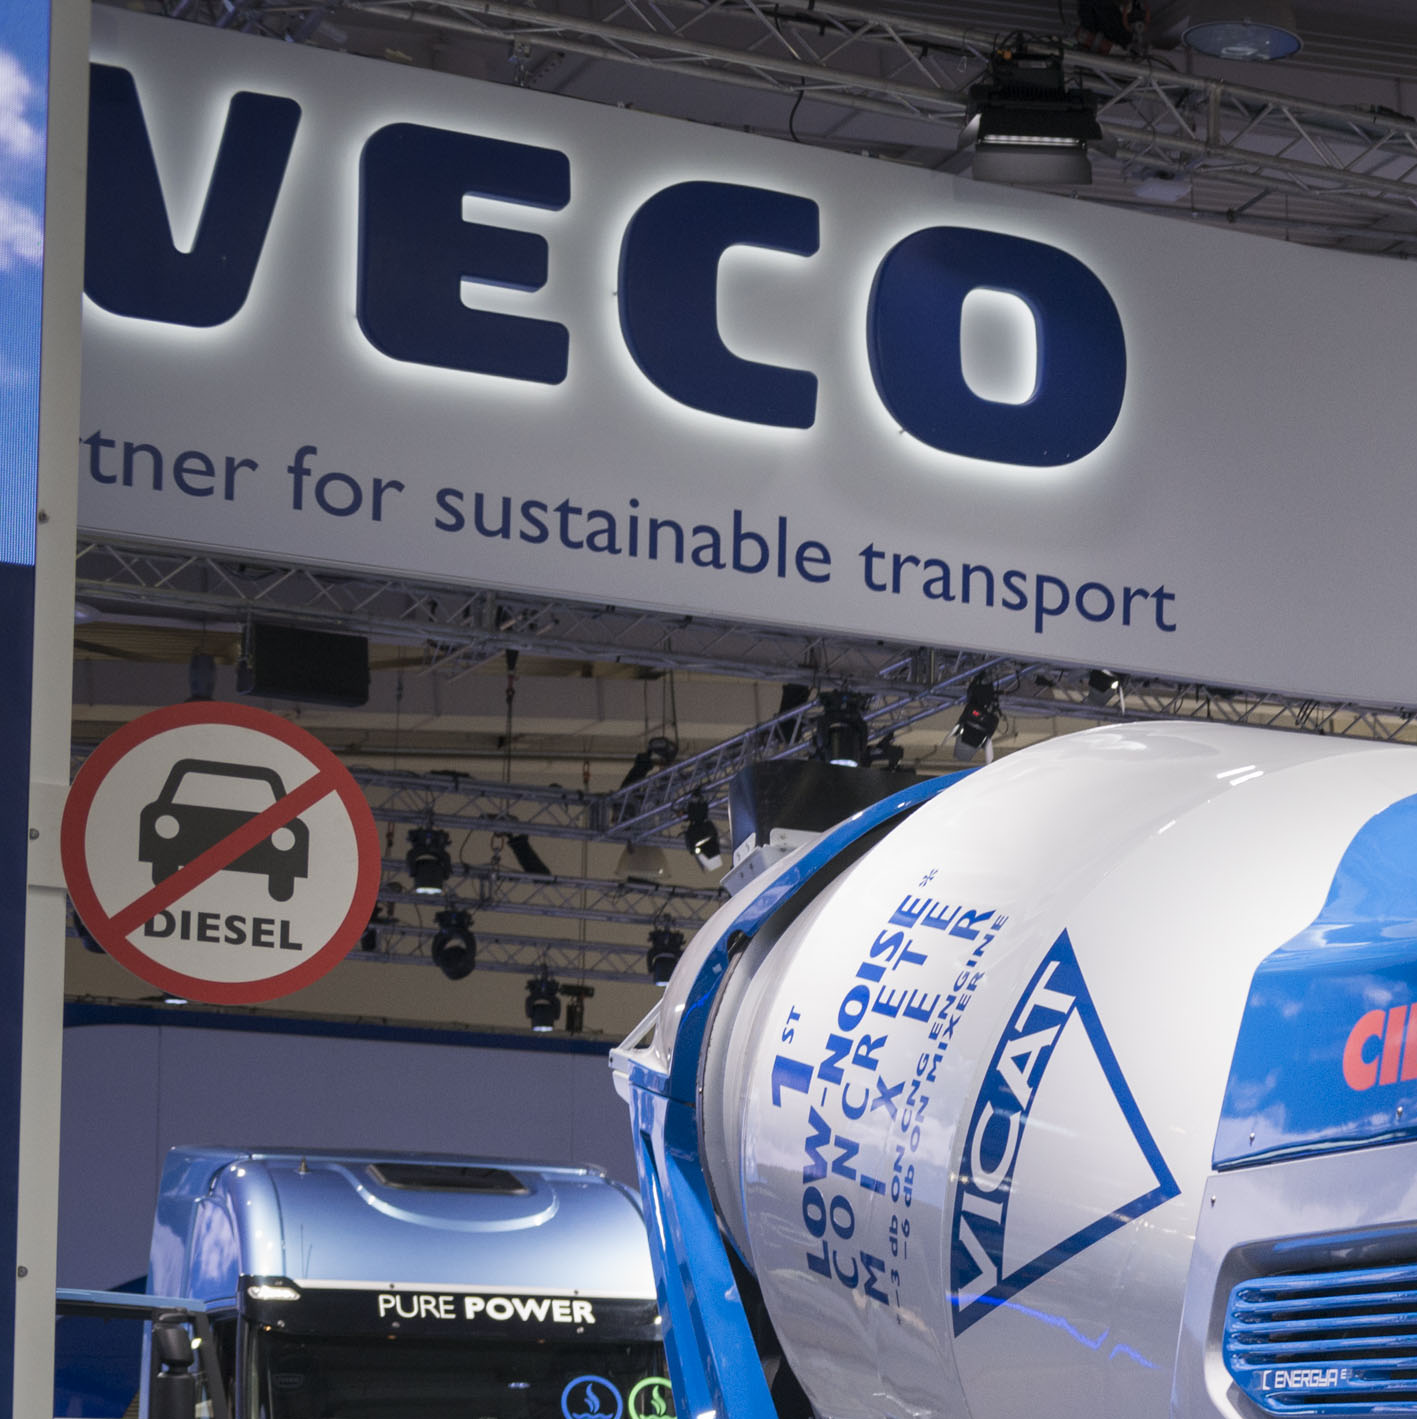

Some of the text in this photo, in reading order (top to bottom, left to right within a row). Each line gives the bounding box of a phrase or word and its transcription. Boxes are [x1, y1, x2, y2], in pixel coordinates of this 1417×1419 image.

[287, 445, 405, 523] for
[434, 477, 834, 583] sustainable
[861, 540, 1179, 635] transport
[143, 906, 304, 953] DIESEL
[830, 898, 955, 1289] CONCRETE
[891, 1145, 906, 1202] ON
[901, 1053, 930, 1133] CNG
[927, 914, 1009, 1041] ENGINE
[910, 1095, 930, 1153] ON
[926, 972, 985, 1082] MIXER
[957, 960, 1079, 1312] VICAT
[378, 1294, 596, 1324] PURE POWER
